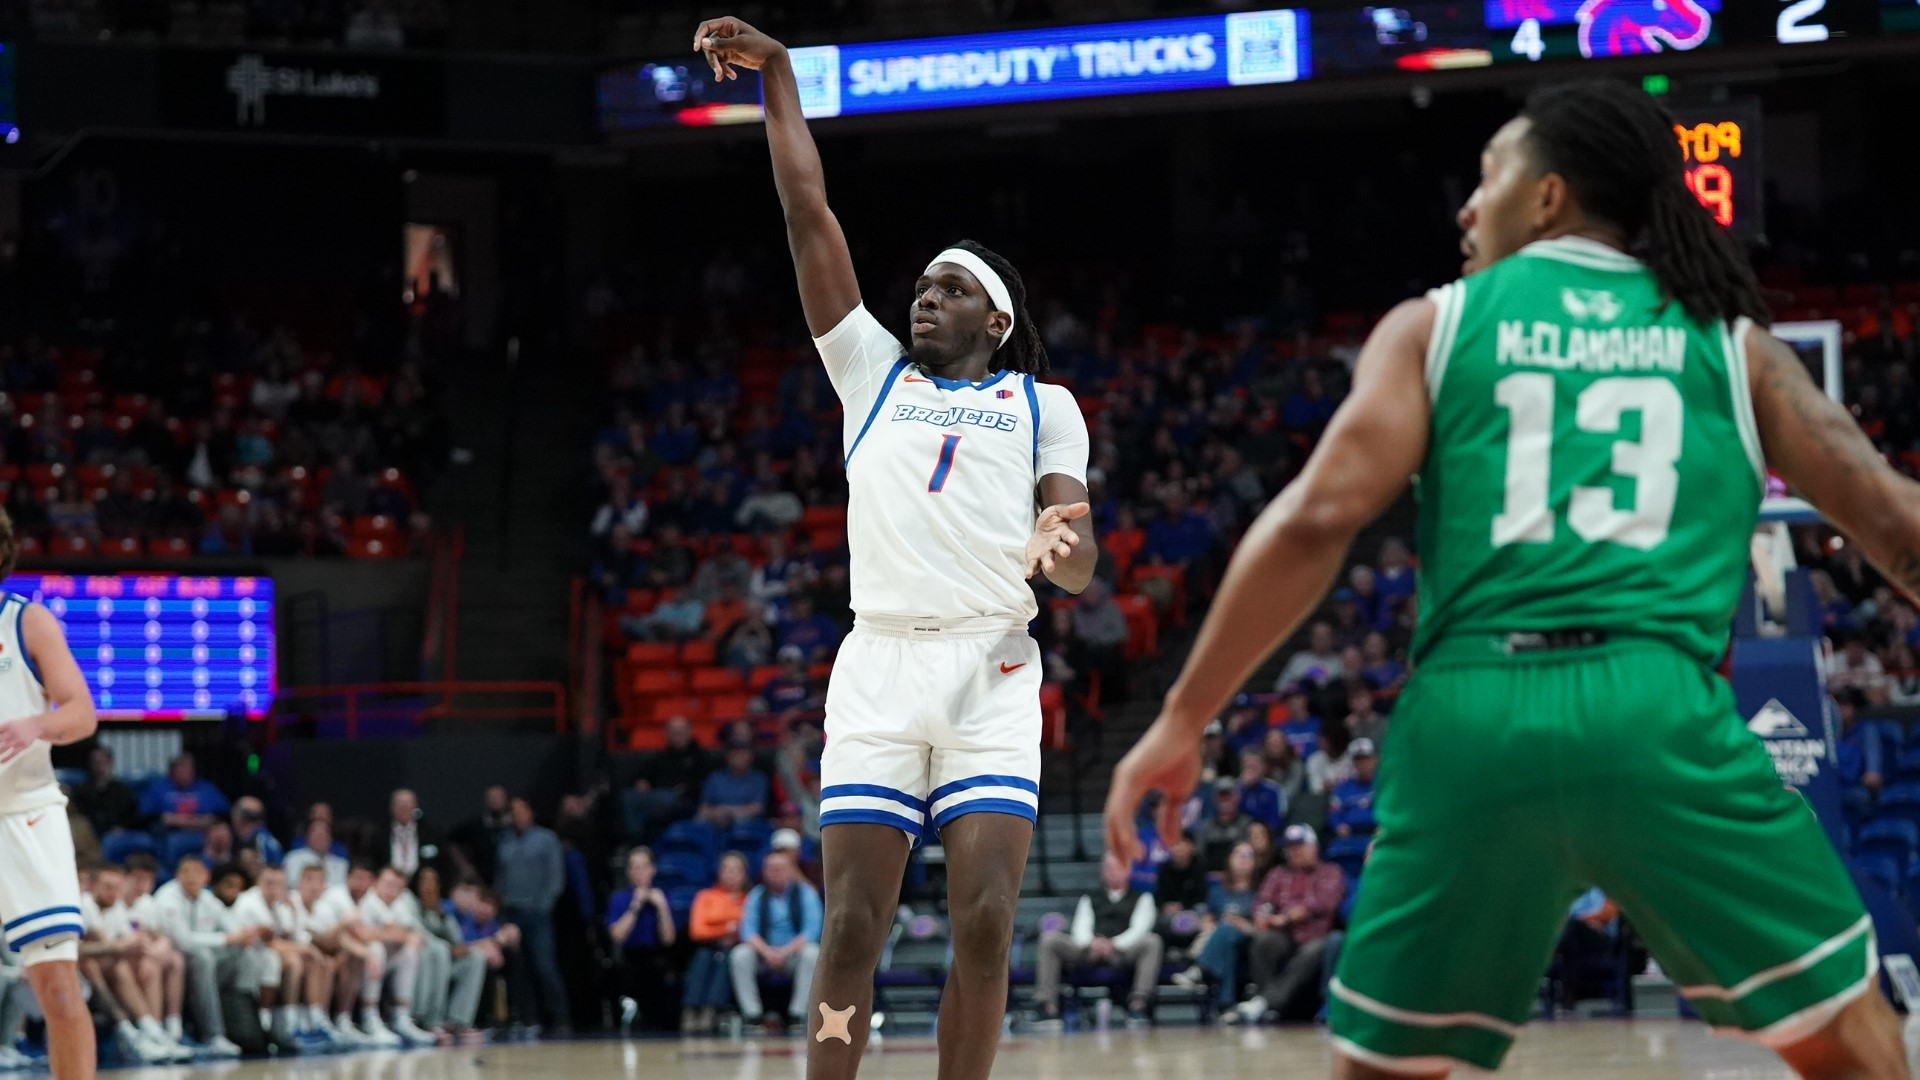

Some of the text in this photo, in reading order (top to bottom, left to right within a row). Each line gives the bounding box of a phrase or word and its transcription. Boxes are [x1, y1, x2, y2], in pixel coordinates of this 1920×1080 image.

[848, 46, 1058, 96] SUPERDUTY
[1073, 32, 1216, 79] TRUCKS
[1510, 17, 1547, 62] 4
[892, 404, 1018, 433] BRONCOS
[928, 433, 963, 493] 1
[1491, 371, 1684, 552] 13
[1763, 738, 1826, 760] NTAIN
